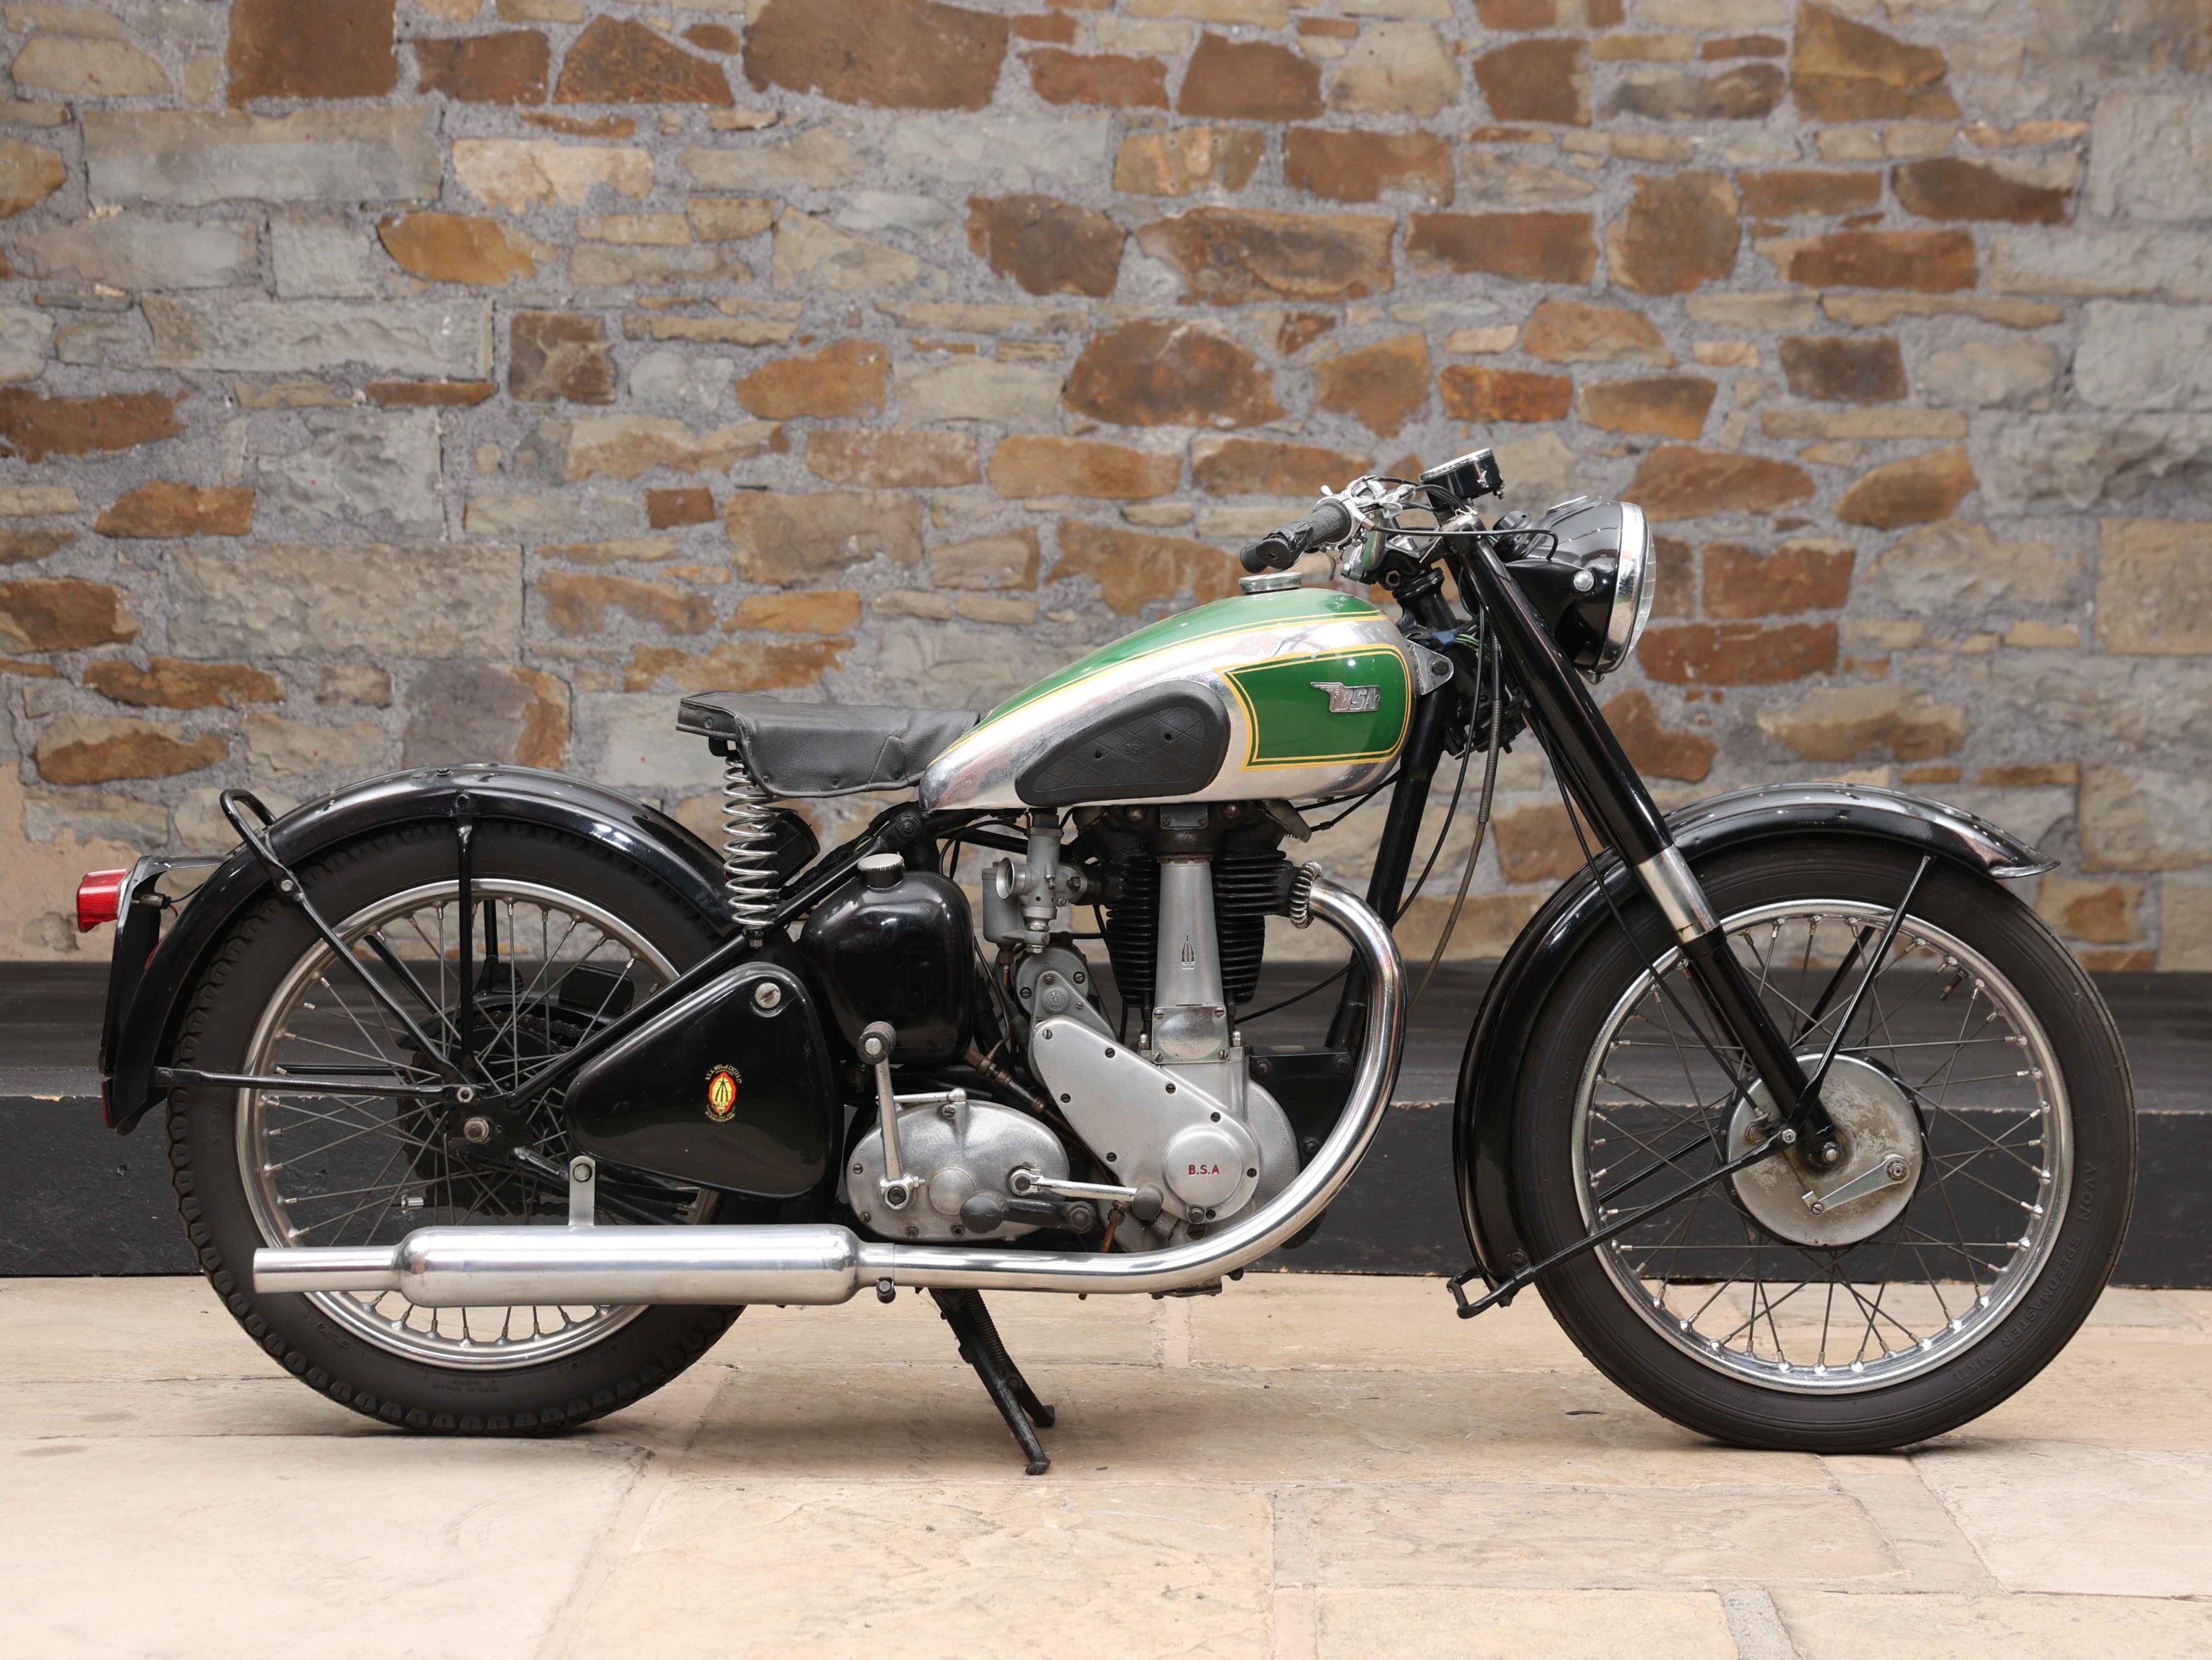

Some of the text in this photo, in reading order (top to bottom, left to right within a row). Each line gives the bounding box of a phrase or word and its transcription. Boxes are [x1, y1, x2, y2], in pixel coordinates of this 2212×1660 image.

[1341, 687, 1377, 710] BSA
[705, 1111, 735, 1122] BIRMINGHAM
[1188, 1165, 1221, 1175] B.S.A
[2075, 1161, 2097, 1222] AVON
[2000, 1234, 2082, 1347] SPEEDMASTER
[1967, 1352, 1992, 1373] MK
